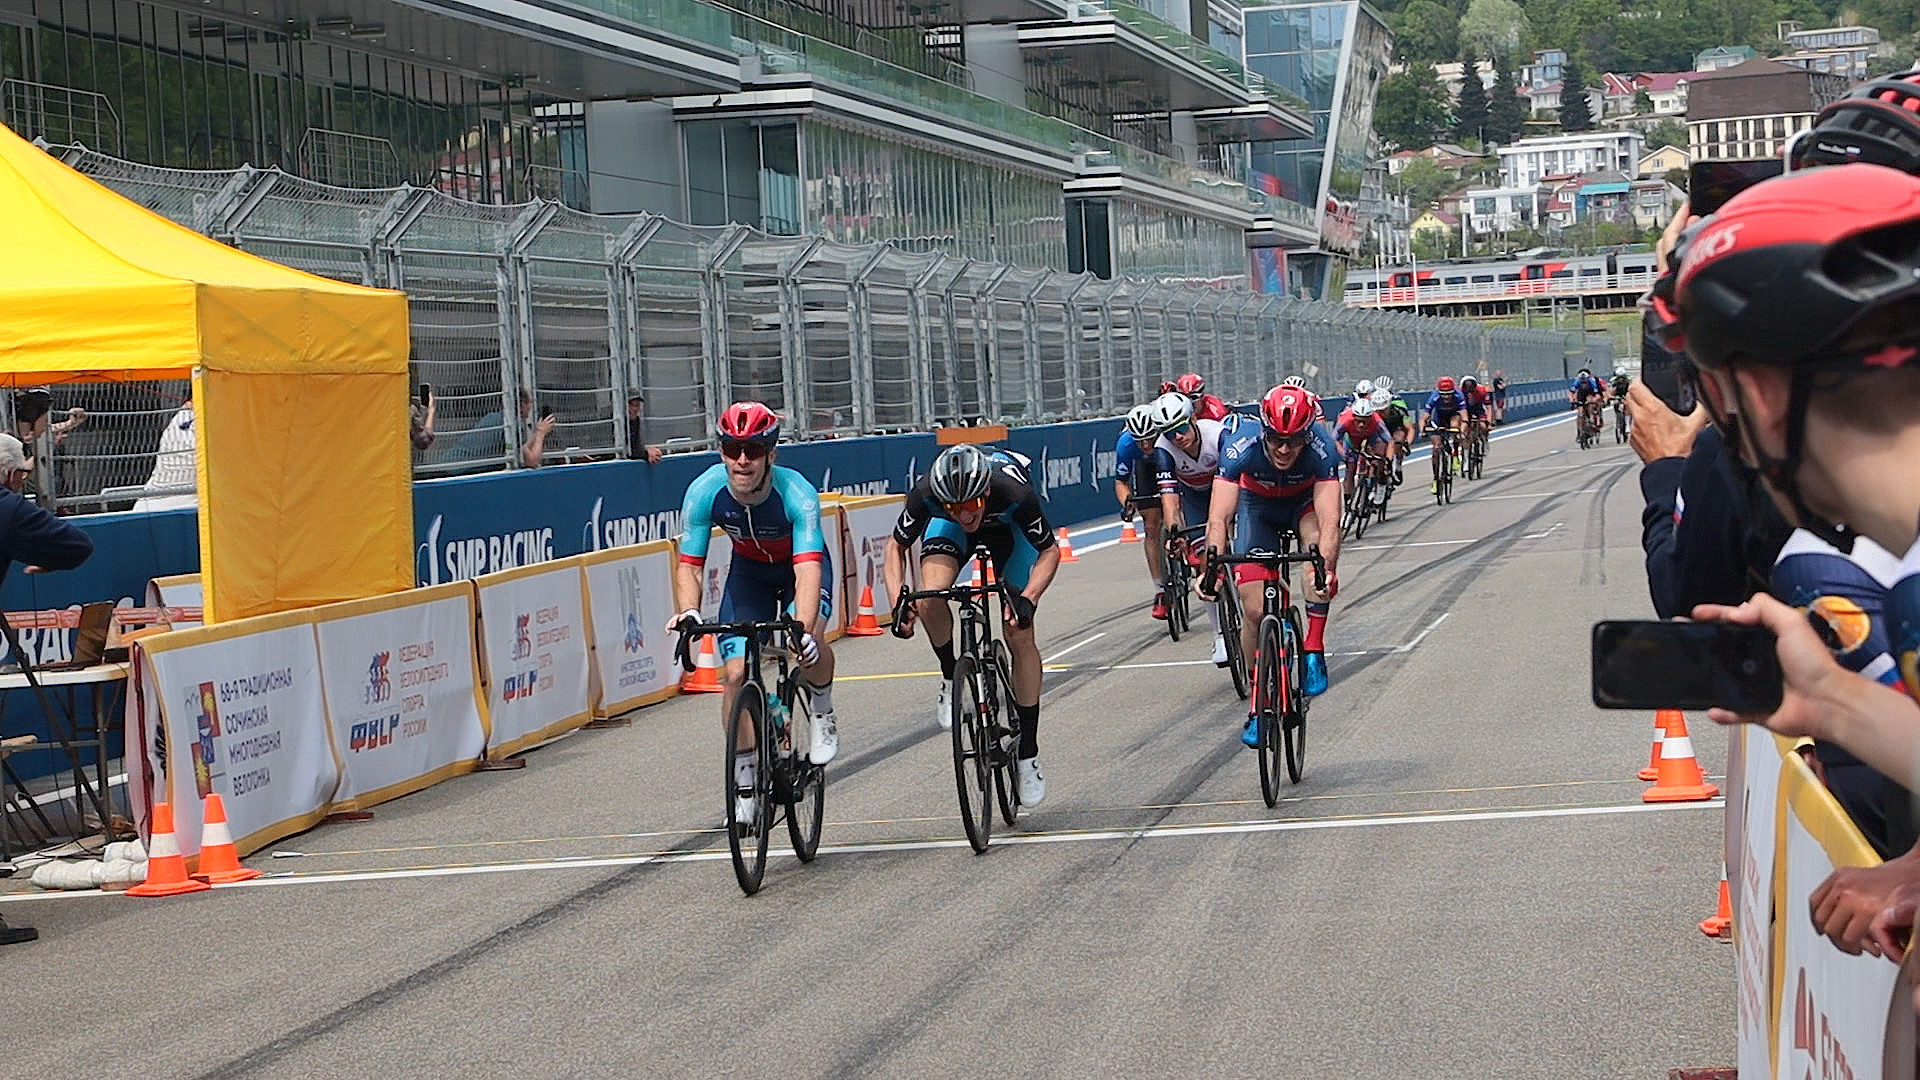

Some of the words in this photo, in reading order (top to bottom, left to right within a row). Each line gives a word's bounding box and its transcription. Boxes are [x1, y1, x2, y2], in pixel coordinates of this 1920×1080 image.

[446, 538, 486, 581] SMP
[489, 527, 553, 575] RACING
[605, 517, 637, 549] SMP
